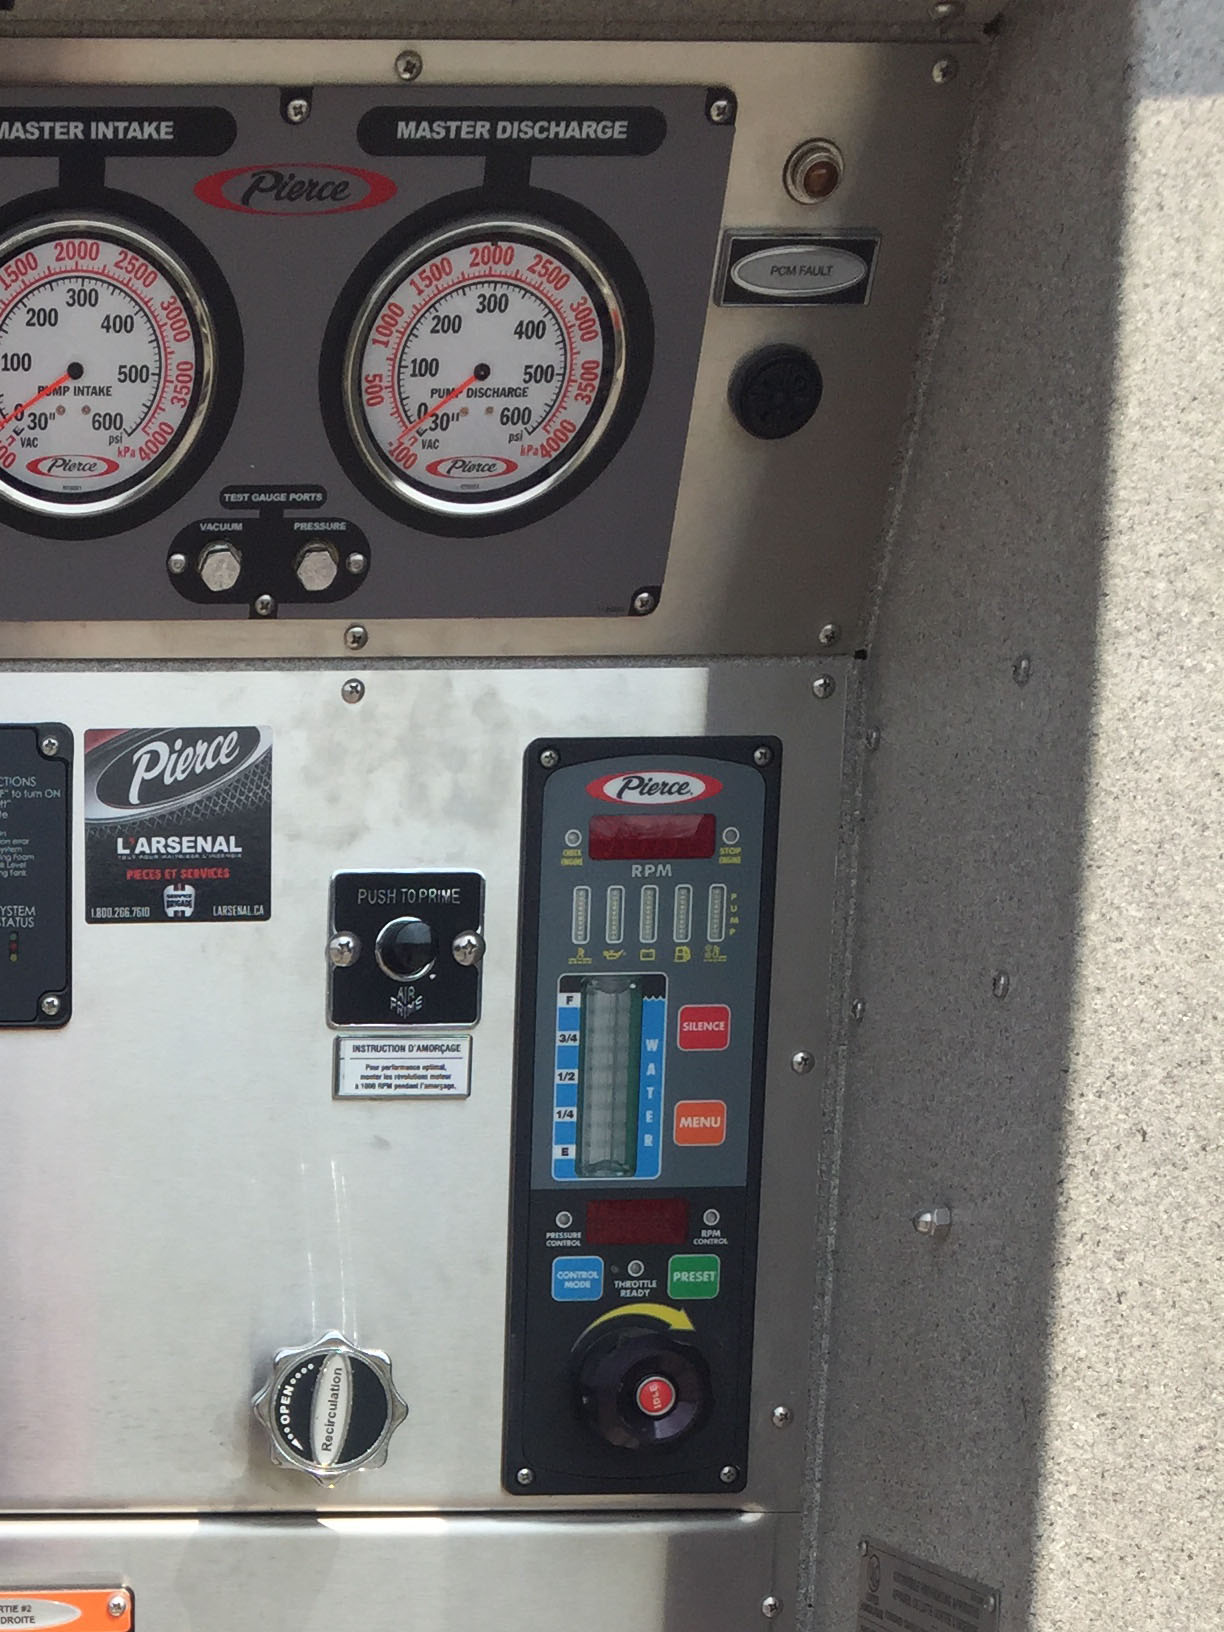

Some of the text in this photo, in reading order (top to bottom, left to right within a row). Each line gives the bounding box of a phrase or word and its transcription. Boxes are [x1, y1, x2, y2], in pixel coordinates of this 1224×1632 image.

[91, 121, 173, 139] INTAKE
[396, 121, 627, 139] MASTER DISCHARGE
[241, 170, 351, 206] Pierce
[770, 266, 833, 276] PCM FAULT
[66, 288, 98, 307] 300
[26, 308, 58, 327] 200
[101, 315, 134, 333] 400
[1, 353, 32, 371] 100
[118, 365, 149, 383] 500
[92, 413, 123, 430] 600
[289, 493, 323, 501] PORTS
[200, 523, 242, 531] VACUUM
[294, 522, 347, 530] PRESSURE
[129, 731, 239, 804] Pierce
[616, 775, 692, 799] Pierce
[117, 836, 242, 854] L'ARSENAL
[164, 868, 176, 879] ET
[180, 868, 230, 879] SERVICES
[632, 864, 672, 878] RPM
[358, 888, 461, 904] PUSH TO PRIME
[213, 905, 264, 916] LARSENAL.CA
[683, 1021, 725, 1031] SILENCE
[353, 1044, 461, 1054] INSTRUCTION D'AMORÇAGE
[679, 1117, 721, 1128] MENU
[615, 1280, 657, 1288] THROTTLE
[673, 1272, 716, 1282] PRESET
[620, 1289, 650, 1297] READY
[280, 1386, 294, 1424] OPEN
[321, 1368, 342, 1451] Recirculation
[0, 1616, 35, 1624] DROITE
